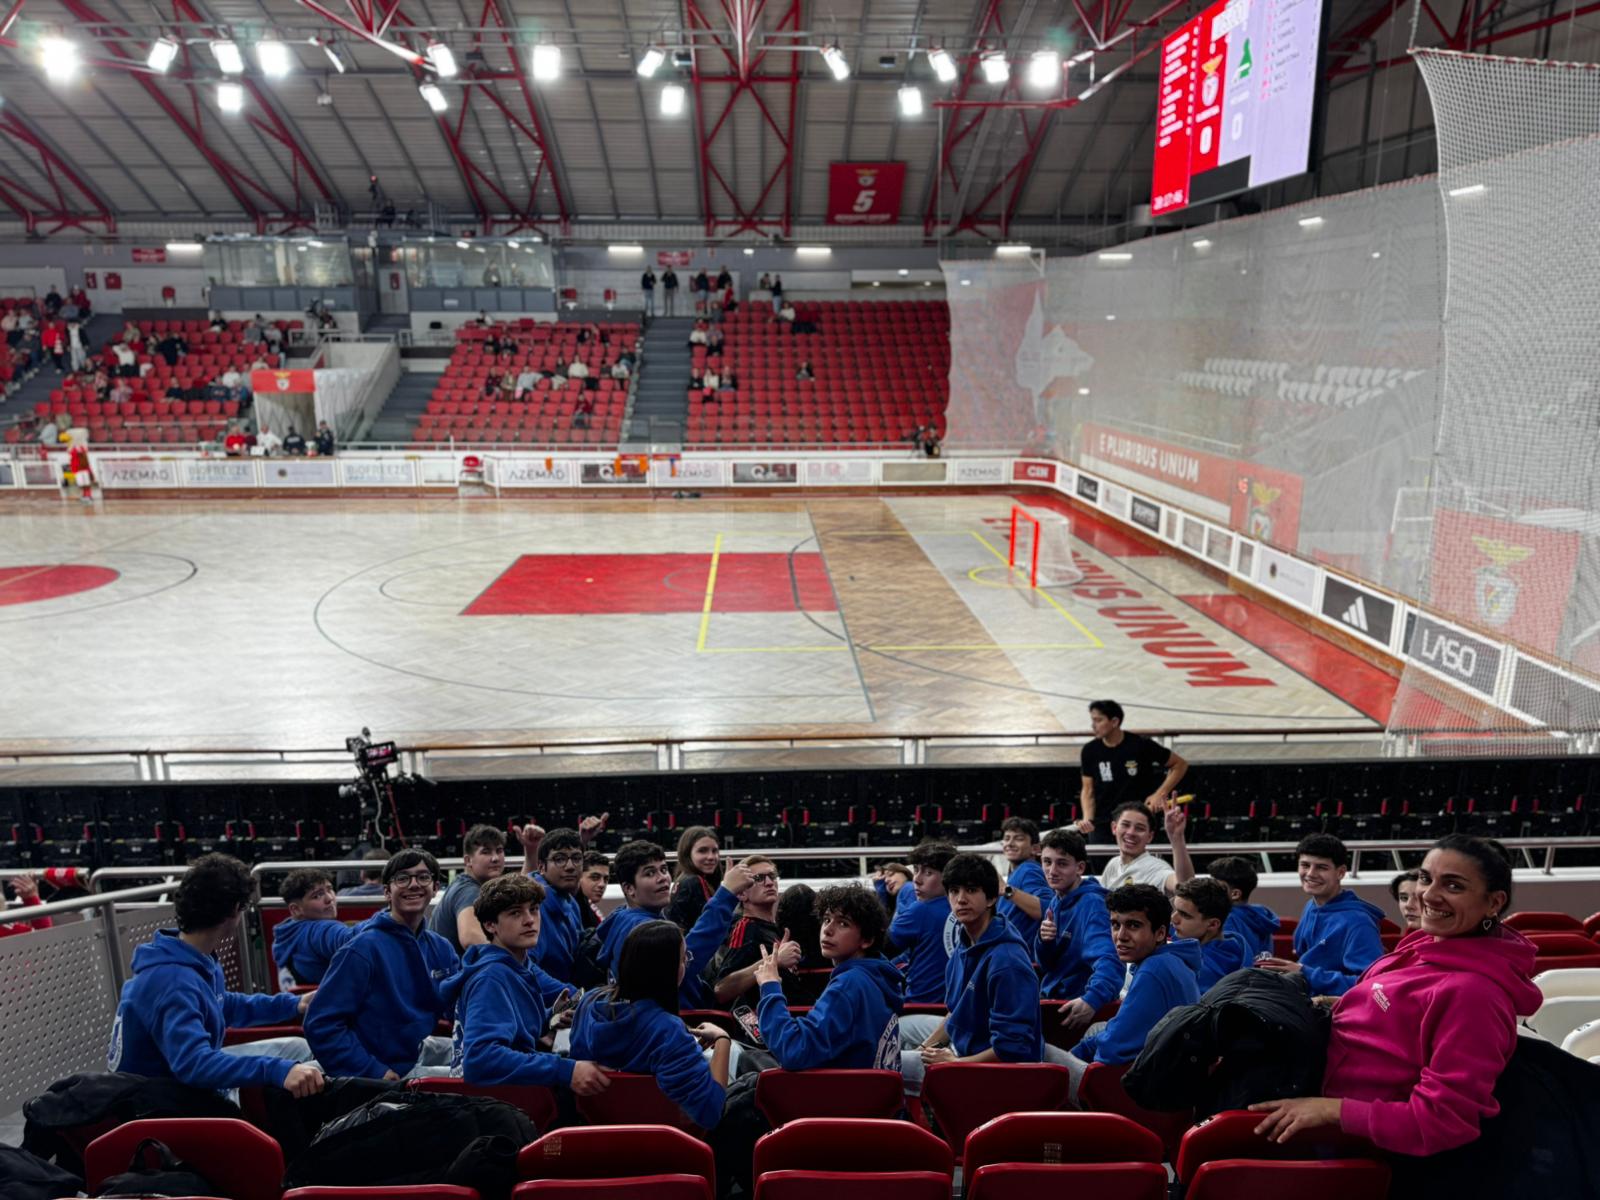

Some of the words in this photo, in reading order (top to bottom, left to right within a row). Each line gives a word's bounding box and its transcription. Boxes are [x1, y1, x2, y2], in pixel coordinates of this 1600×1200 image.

[1200, 126, 1212, 154] 0
[852, 190, 876, 212] 5
[1100, 432, 1107, 453] E
[1107, 434, 1158, 469] PLURIBUS
[1159, 449, 1199, 483] UNUM
[111, 469, 170, 481] AZEMAD
[509, 469, 566, 481] AZEMAD
[671, 469, 712, 479] ZEMAD
[1097, 606, 1278, 688] UNUM
[1421, 628, 1477, 678] LASO
